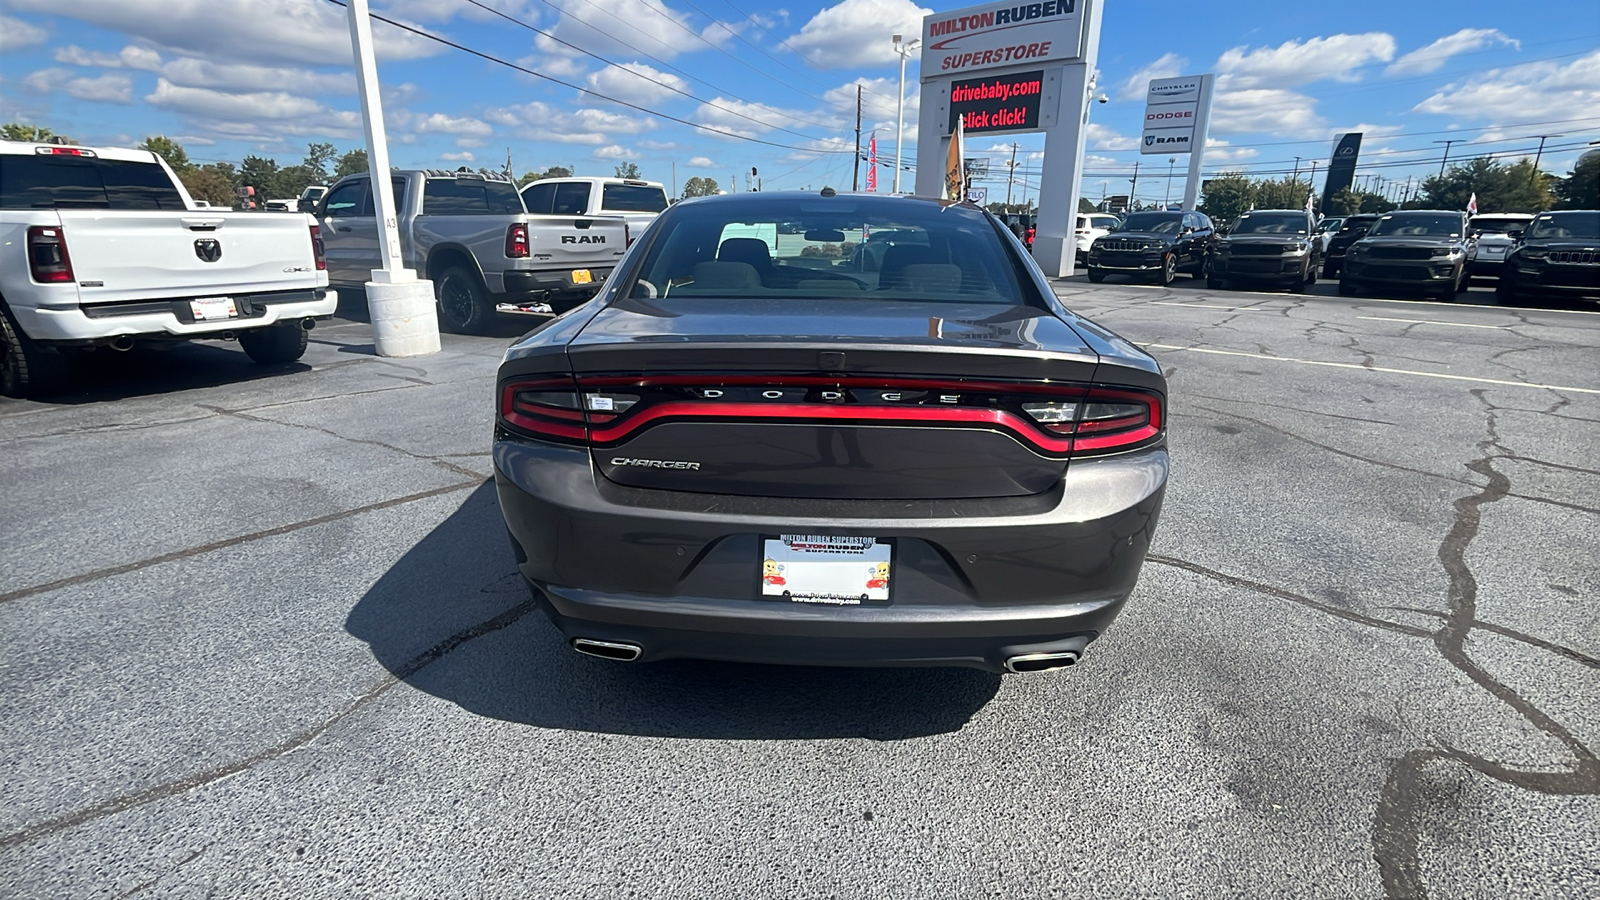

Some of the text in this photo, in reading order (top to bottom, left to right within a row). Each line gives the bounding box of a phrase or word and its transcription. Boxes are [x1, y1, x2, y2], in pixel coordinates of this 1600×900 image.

[930, 0, 1075, 37] MILTON RUBEN
[942, 41, 1052, 70] SUPERSTORE
[952, 80, 1040, 102] drivebaby.com
[963, 107, 1027, 128] click click!
[1147, 111, 1192, 120] DODGE
[387, 218, 396, 228] A3
[561, 236, 606, 244] RAM
[704, 388, 960, 404] DODGE
[610, 457, 701, 471] CHARGER
[780, 534, 876, 544] MILTON RUBEN SUPERSTORE
